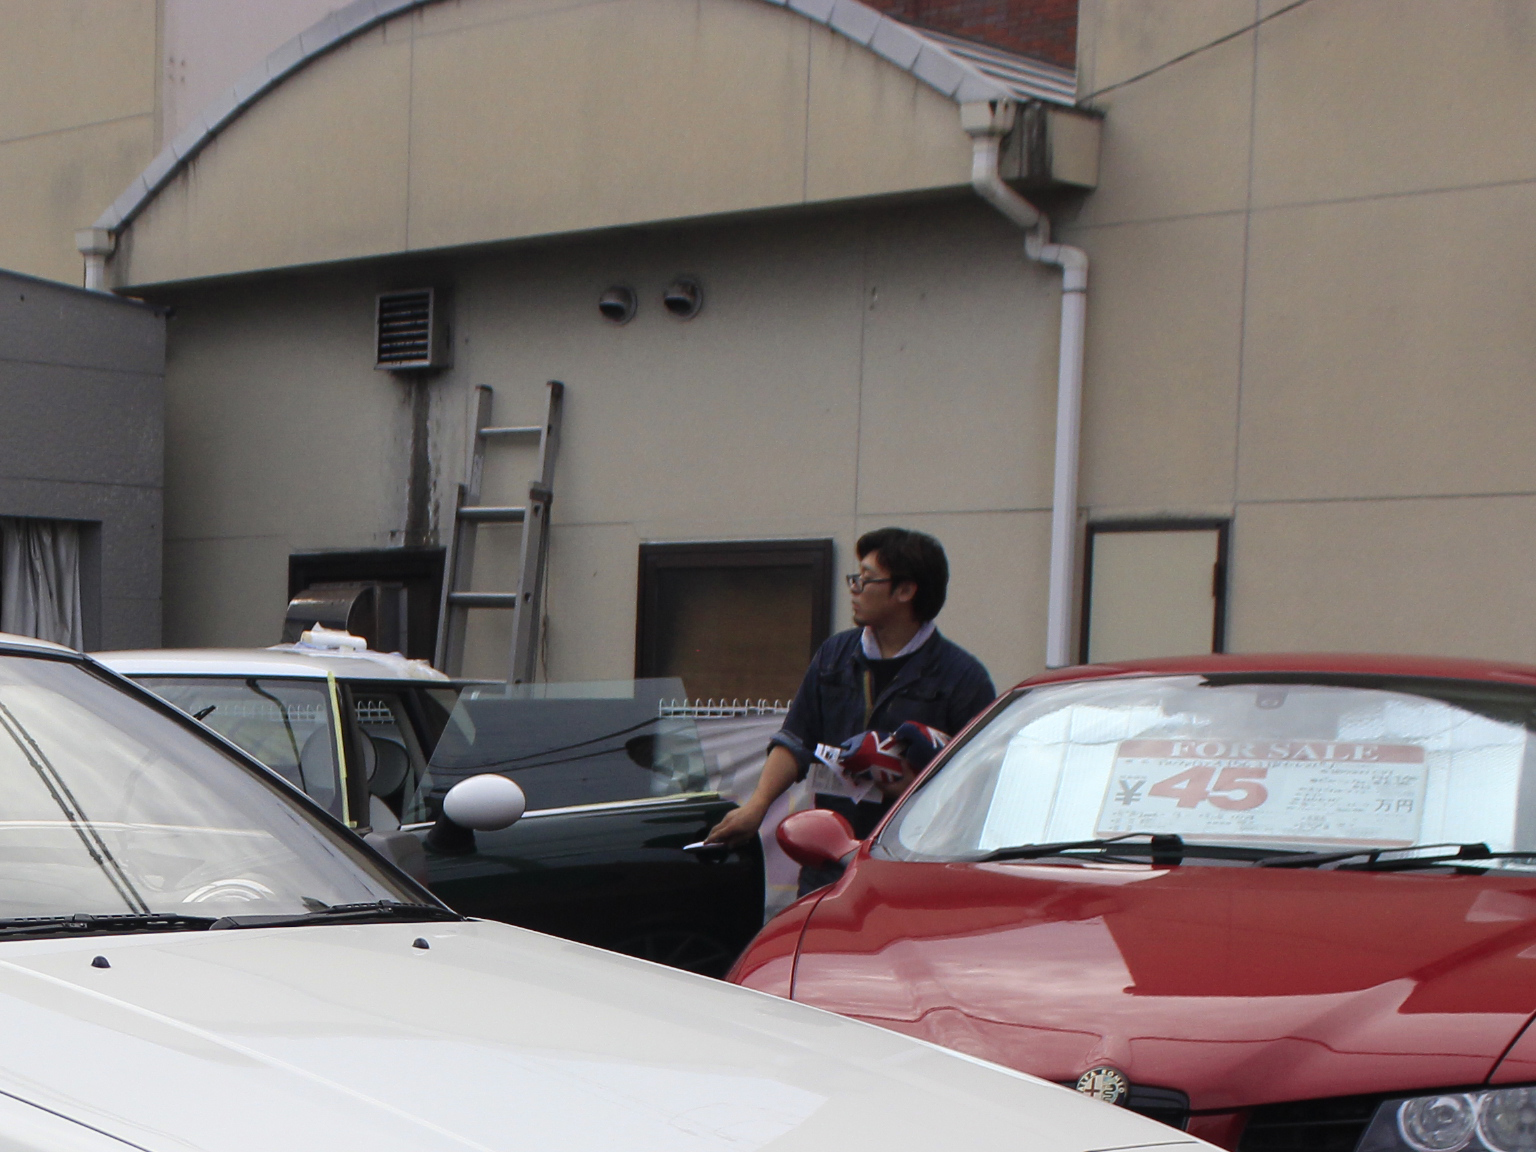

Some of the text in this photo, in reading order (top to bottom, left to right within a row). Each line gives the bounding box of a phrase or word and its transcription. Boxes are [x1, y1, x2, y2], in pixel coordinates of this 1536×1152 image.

[1170, 741, 1256, 759] FOR
[1268, 742, 1380, 762] SALE
[1101, 1069, 1126, 1094] ROMEO
